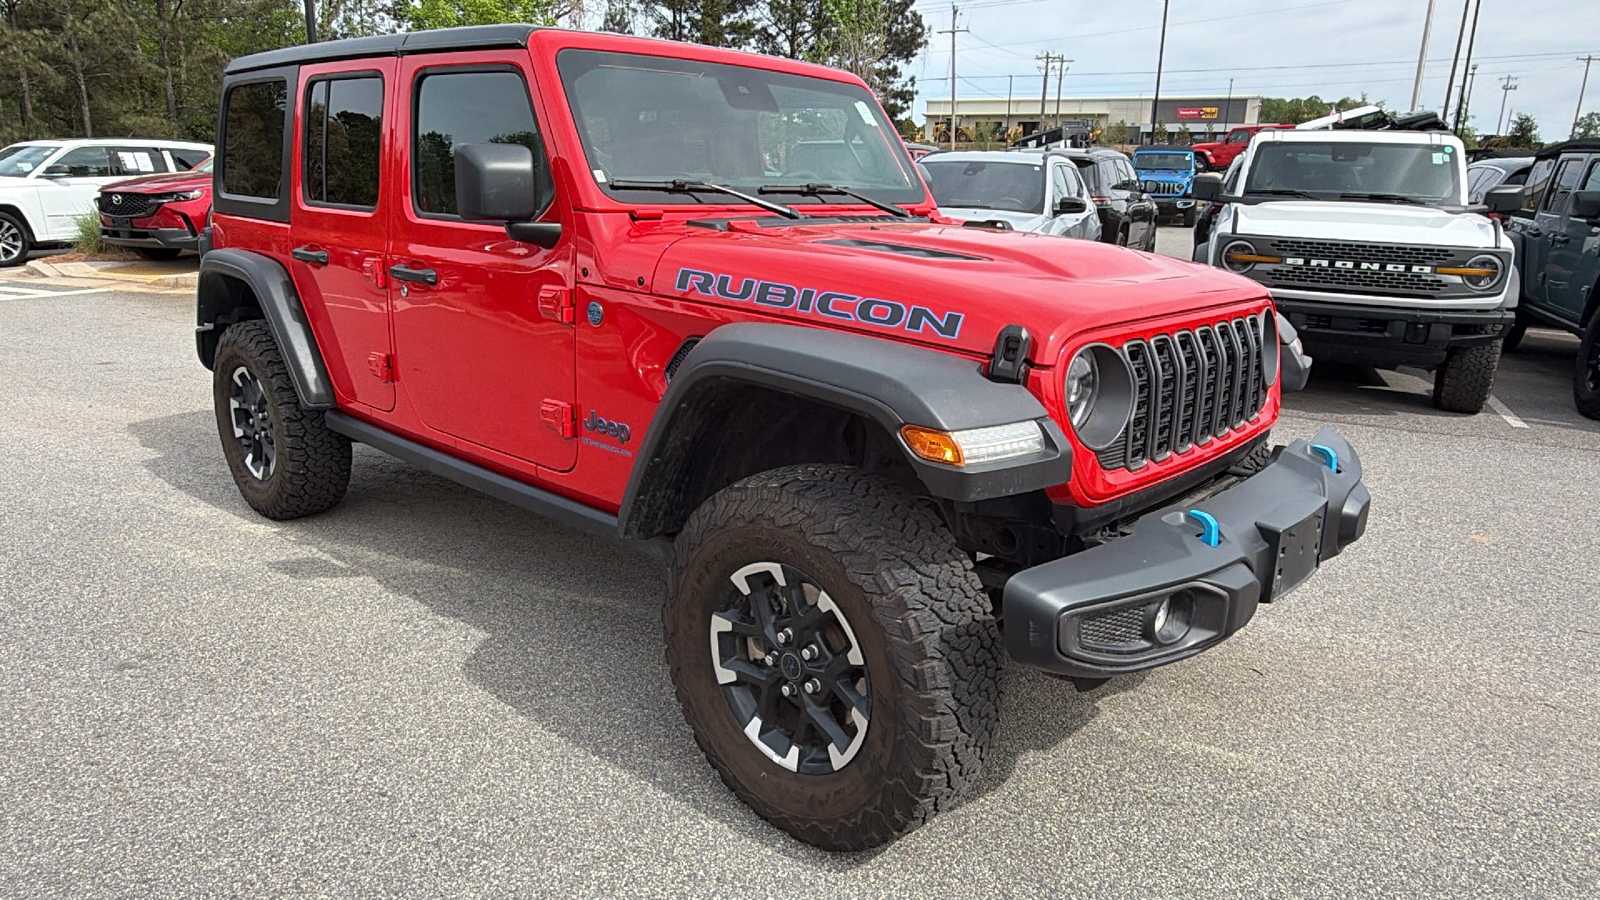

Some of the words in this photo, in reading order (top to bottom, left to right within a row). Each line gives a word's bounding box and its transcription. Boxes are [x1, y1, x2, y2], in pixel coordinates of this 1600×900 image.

[1286, 257, 1431, 274] BRONCO
[675, 267, 965, 339] RUBICON
[583, 409, 631, 445] Jeep
